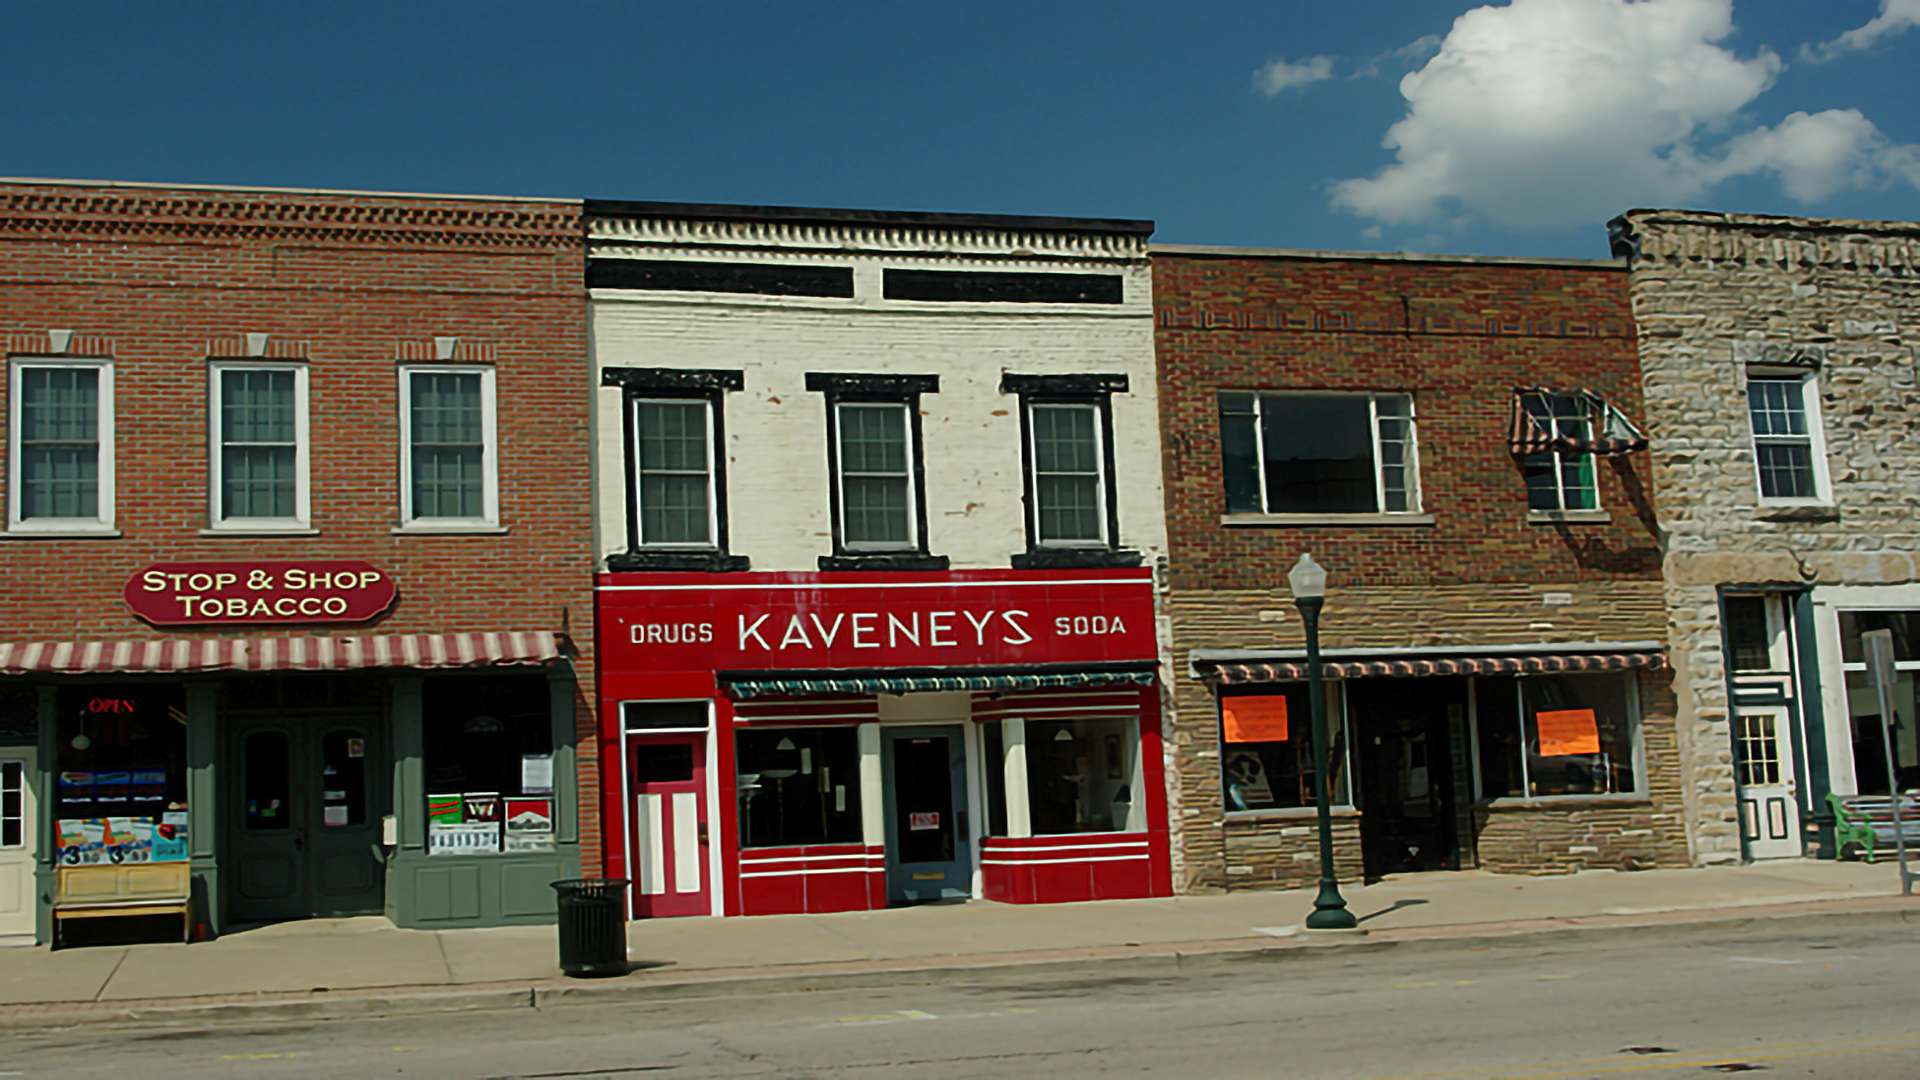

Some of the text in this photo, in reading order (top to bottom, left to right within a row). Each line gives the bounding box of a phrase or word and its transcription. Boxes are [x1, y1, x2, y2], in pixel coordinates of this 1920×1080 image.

[143, 569, 381, 592] STOP & SHOP
[176, 596, 348, 617] TOBACCO
[630, 622, 713, 644] DRUGS
[738, 610, 1033, 650] KAVENEYS
[1056, 615, 1127, 636] SODA
[87, 697, 136, 713] OPEN
